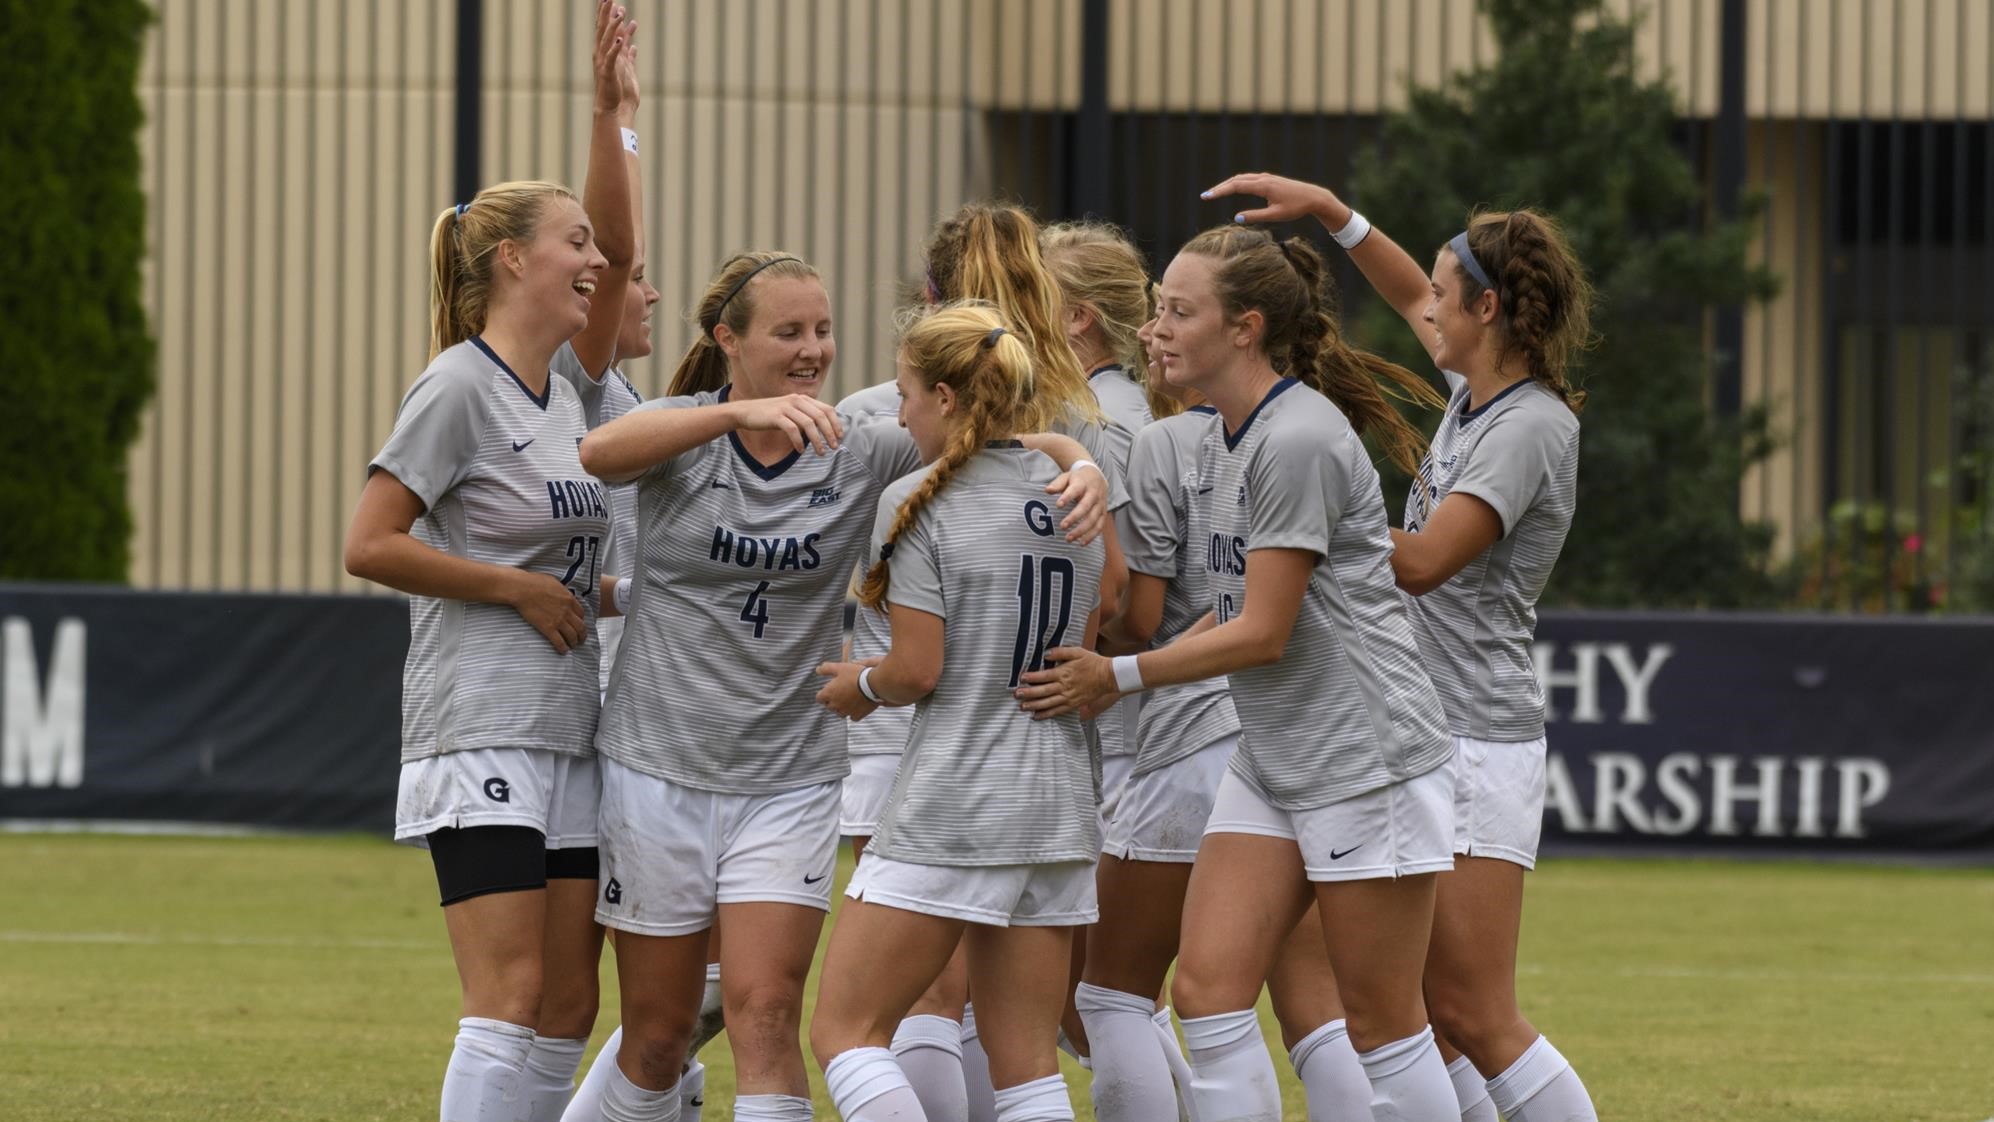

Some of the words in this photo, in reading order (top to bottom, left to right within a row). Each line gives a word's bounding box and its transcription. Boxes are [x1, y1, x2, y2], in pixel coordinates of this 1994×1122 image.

[1023, 499, 1056, 537] G
[709, 525, 822, 571] HOYAS
[739, 580, 770, 639] 4
[1, 616, 87, 788] M
[483, 777, 510, 803] G
[604, 876, 622, 905] G
